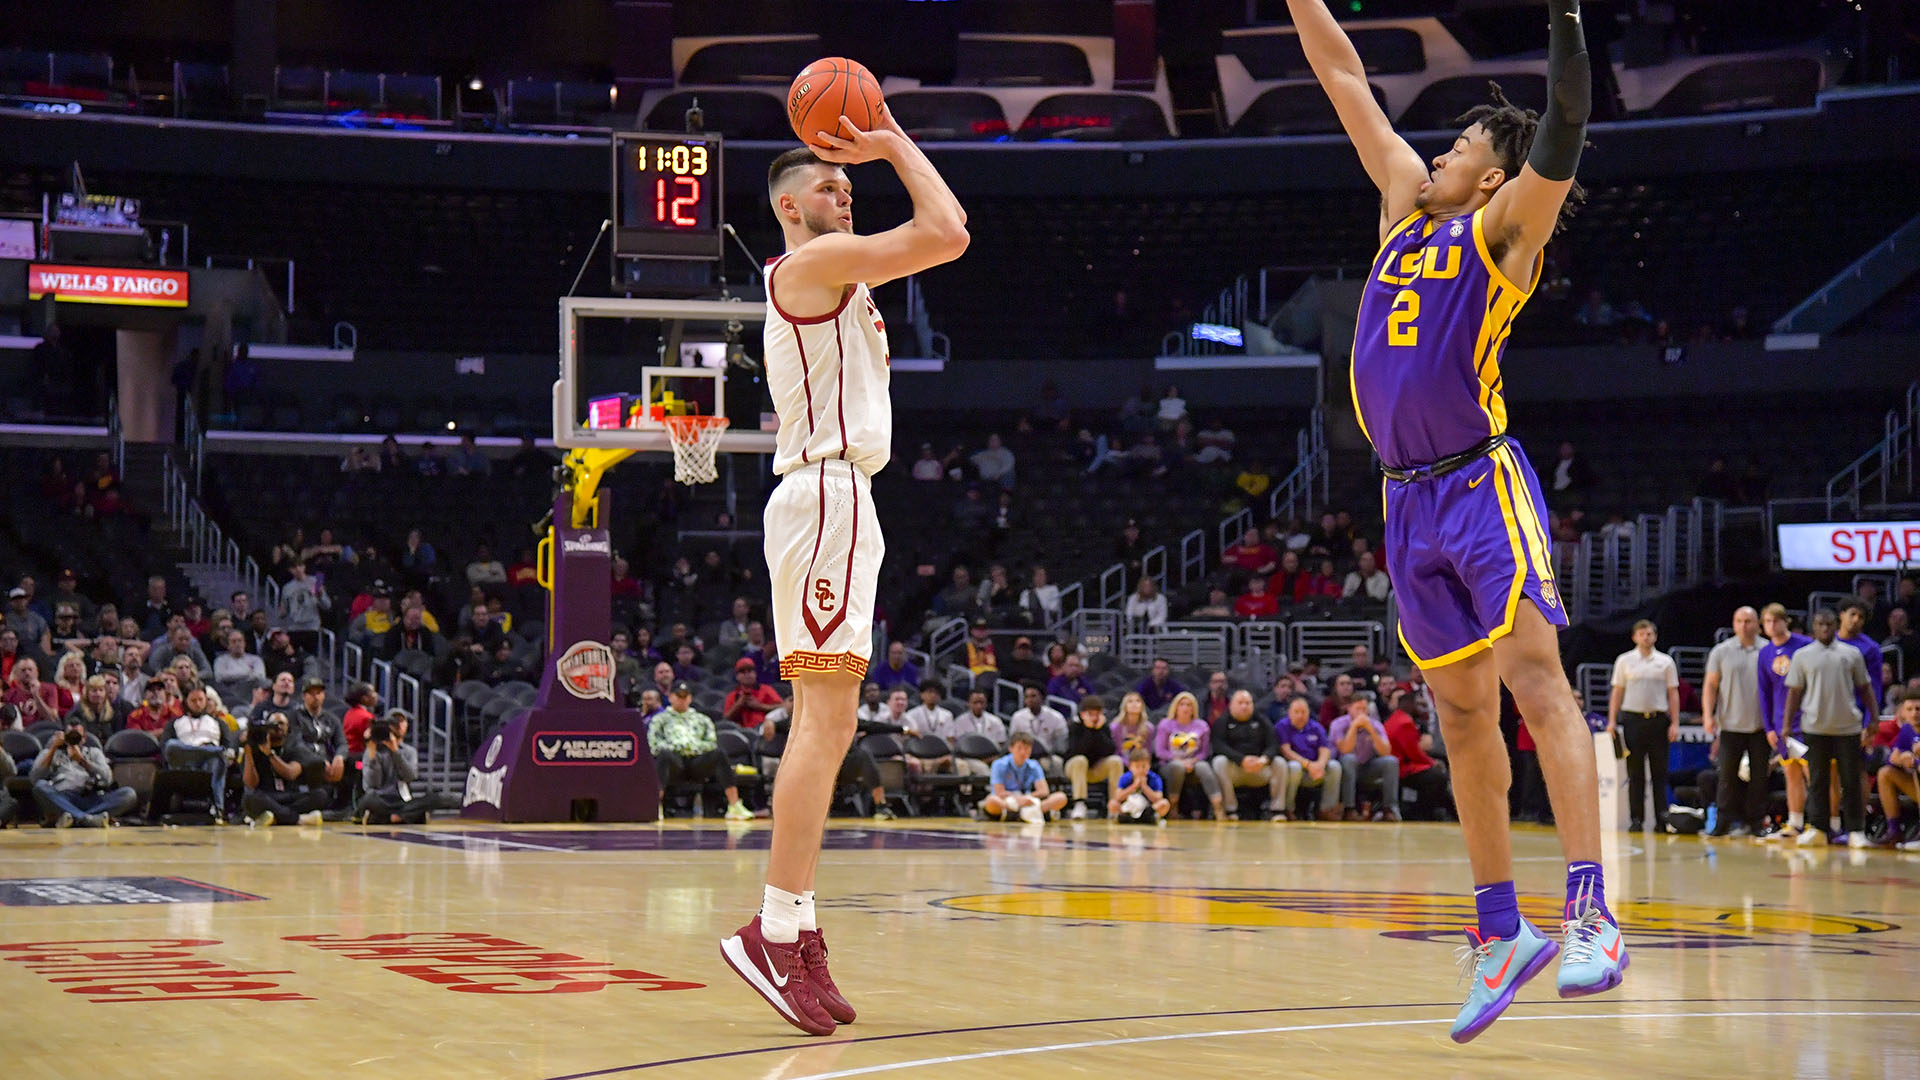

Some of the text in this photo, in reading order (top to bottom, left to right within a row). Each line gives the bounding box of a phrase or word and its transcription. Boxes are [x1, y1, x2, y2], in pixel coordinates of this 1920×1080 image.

[639, 145, 708, 175] 11:03
[656, 176, 699, 226] 12
[1377, 245, 1462, 286] LSU
[40, 272, 178, 295] WELLS FARGO
[1387, 289, 1420, 346] 2
[1831, 529, 1920, 563] STAP
[562, 741, 632, 750] AIR FORCE
[566, 750, 629, 759] RESERVE
[280, 932, 707, 994] STAPLES
